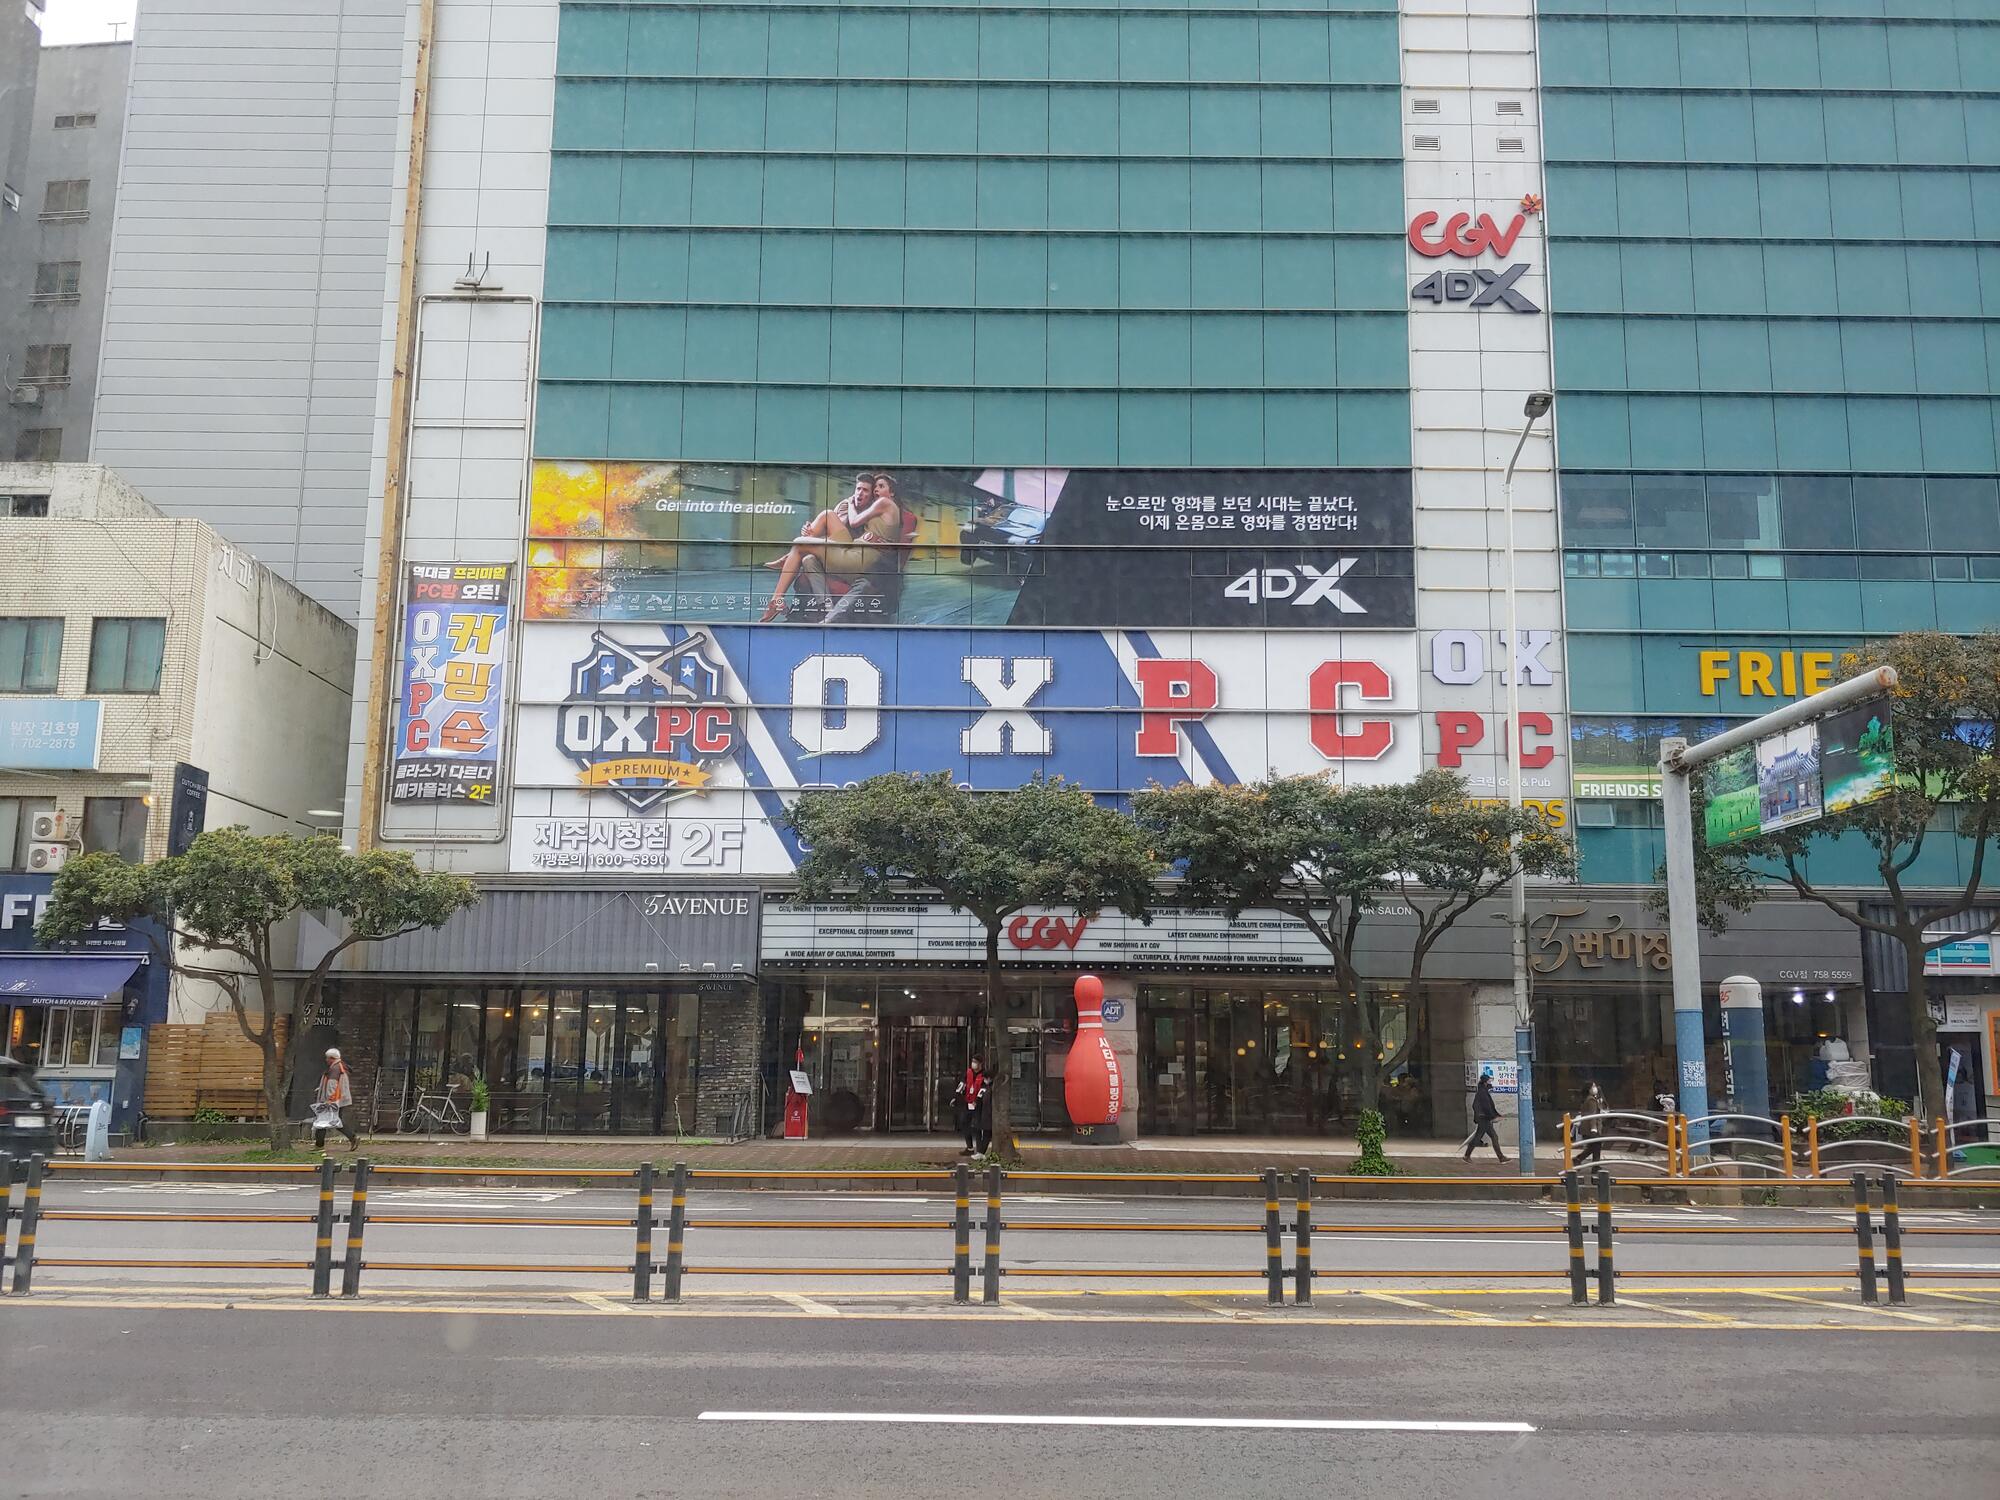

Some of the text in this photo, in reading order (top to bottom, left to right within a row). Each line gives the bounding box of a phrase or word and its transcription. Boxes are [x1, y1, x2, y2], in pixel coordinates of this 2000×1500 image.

[1409, 210, 1527, 258] CGV
[1412, 264, 1541, 313] 4DX
[656, 499, 796, 514] Get into the action.
[1106, 496, 1358, 512] 눈으로만 영화를 보던 시대는 끝났다.
[1140, 515, 1358, 531] 이제 온몸으로 영화를 경험한다!
[218, 545, 253, 590] 치과
[461, 584, 500, 600] 오픈!
[1224, 558, 1368, 613] 4DX
[562, 706, 733, 753] OXPC
[449, 765, 493, 780] 다르다
[614, 765, 680, 777] PREMIUM
[1521, 778, 1529, 788] &
[1531, 777, 1551, 788] Pub
[1581, 784, 1649, 797] FRIENDS
[469, 785, 492, 799] 2F
[534, 821, 745, 866] 제주시청점 2F
[532, 853, 669, 866] 가맹문의 1600-5890
[660, 898, 748, 915] AVENUE
[1378, 906, 1412, 915] SALON
[1008, 915, 1088, 949] CGV
[1813, 970, 1829, 979] 758
[1831, 971, 1852, 979] 5559
[1104, 1006, 1120, 1015] ADT
